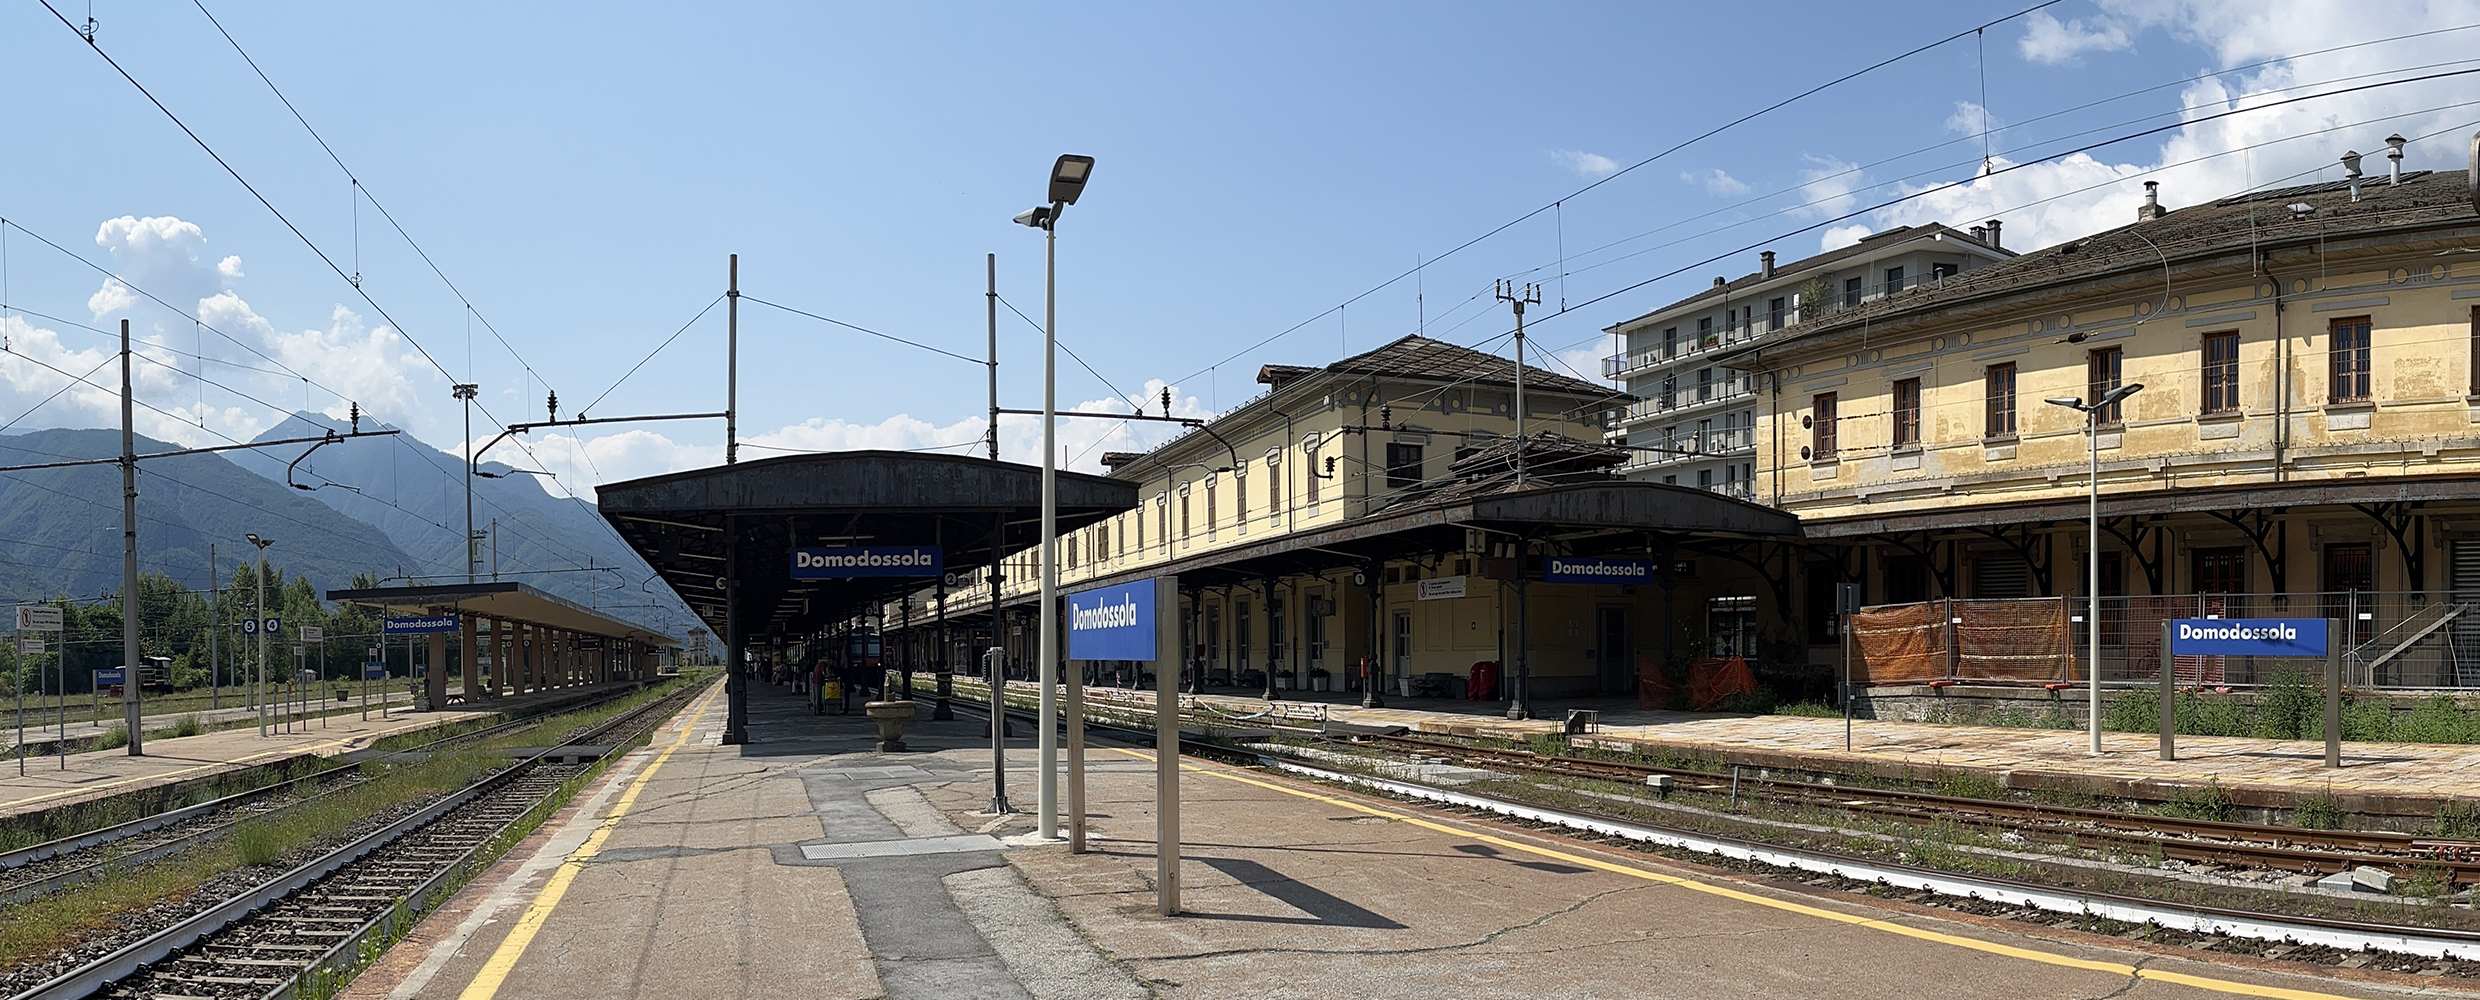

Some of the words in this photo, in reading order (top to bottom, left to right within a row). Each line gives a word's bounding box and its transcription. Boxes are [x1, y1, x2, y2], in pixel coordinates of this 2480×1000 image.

[797, 549, 932, 568] Domodossola
[1552, 560, 1645, 576] Domodossola
[947, 575, 954, 583] 2
[1358, 575, 1362, 583] 1
[1073, 592, 1136, 631] Domodossola
[246, 622, 253, 630] 5
[269, 621, 276, 629] 4
[387, 618, 453, 629] Domodossola
[2180, 623, 2297, 640] Domodossola
